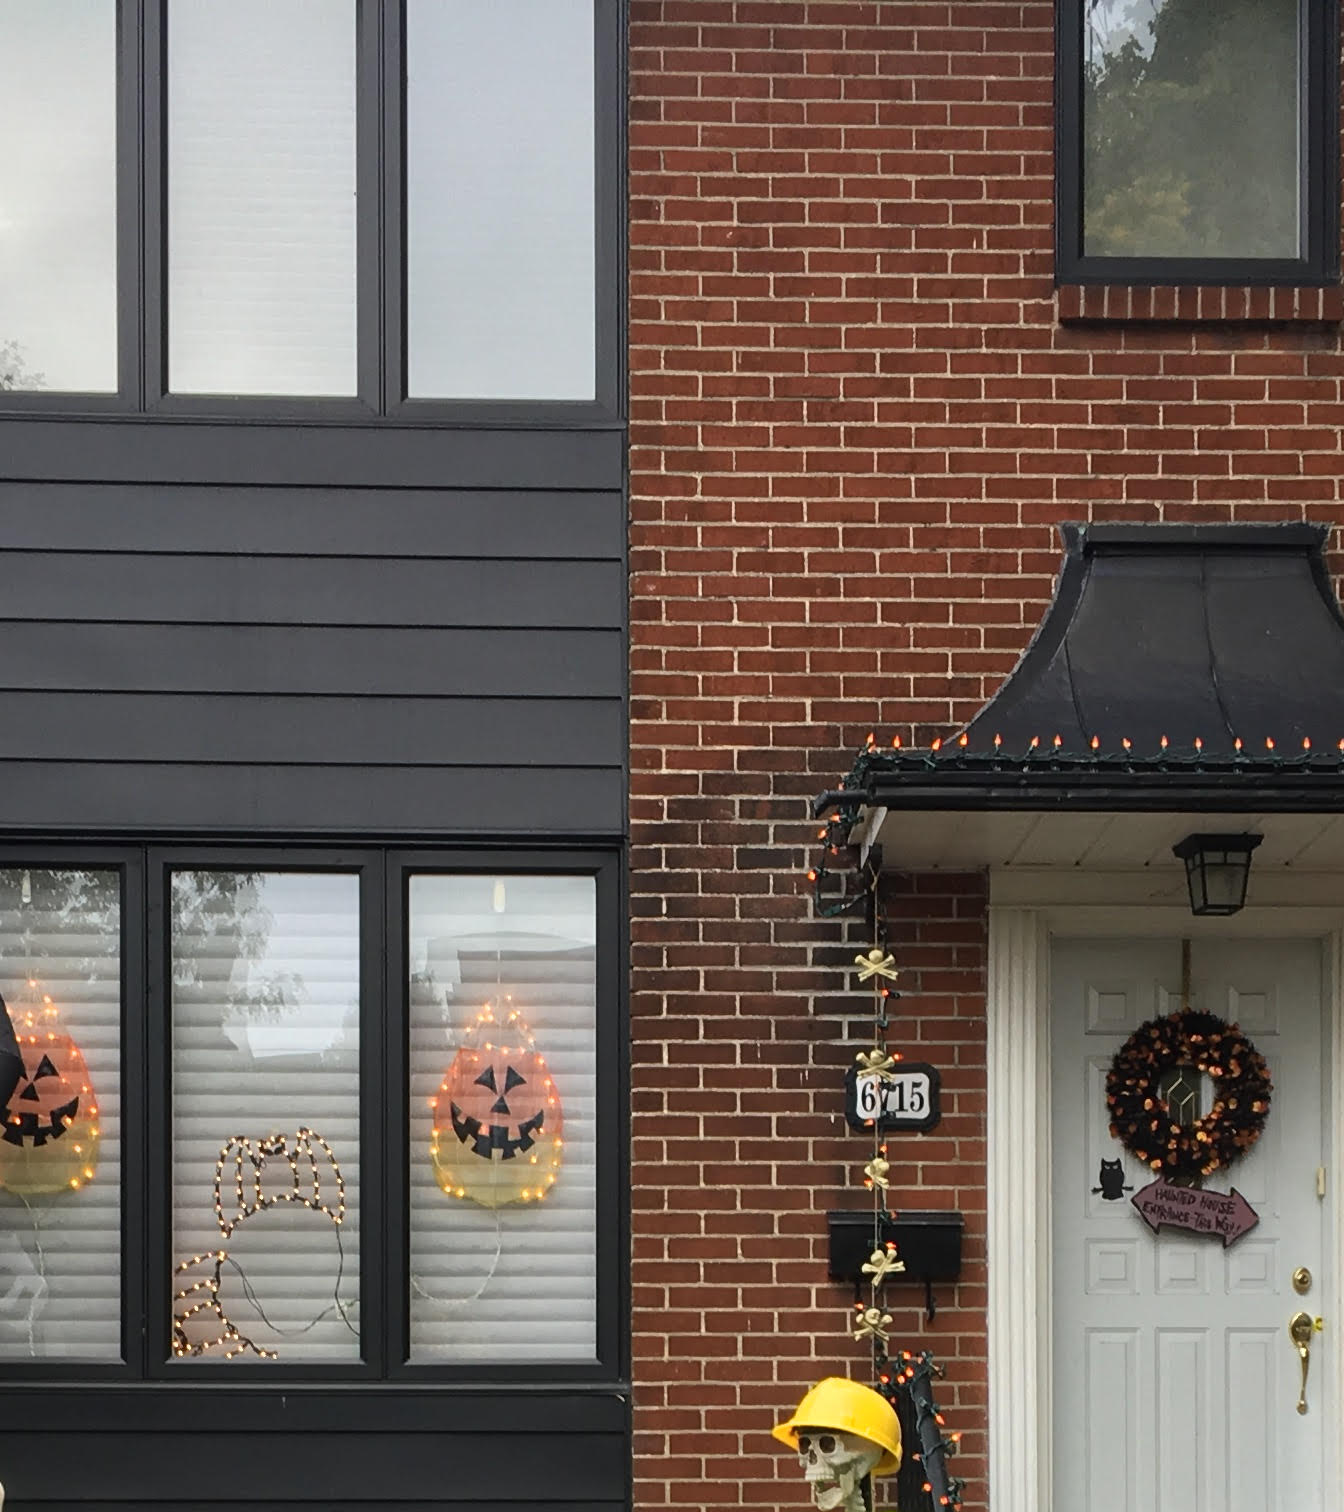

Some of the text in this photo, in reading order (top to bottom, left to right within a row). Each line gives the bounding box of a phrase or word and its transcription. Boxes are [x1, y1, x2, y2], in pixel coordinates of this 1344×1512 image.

[861, 1080, 925, 1113] 6715
[1155, 1188, 1236, 1215] HAUNTED HOUSE
